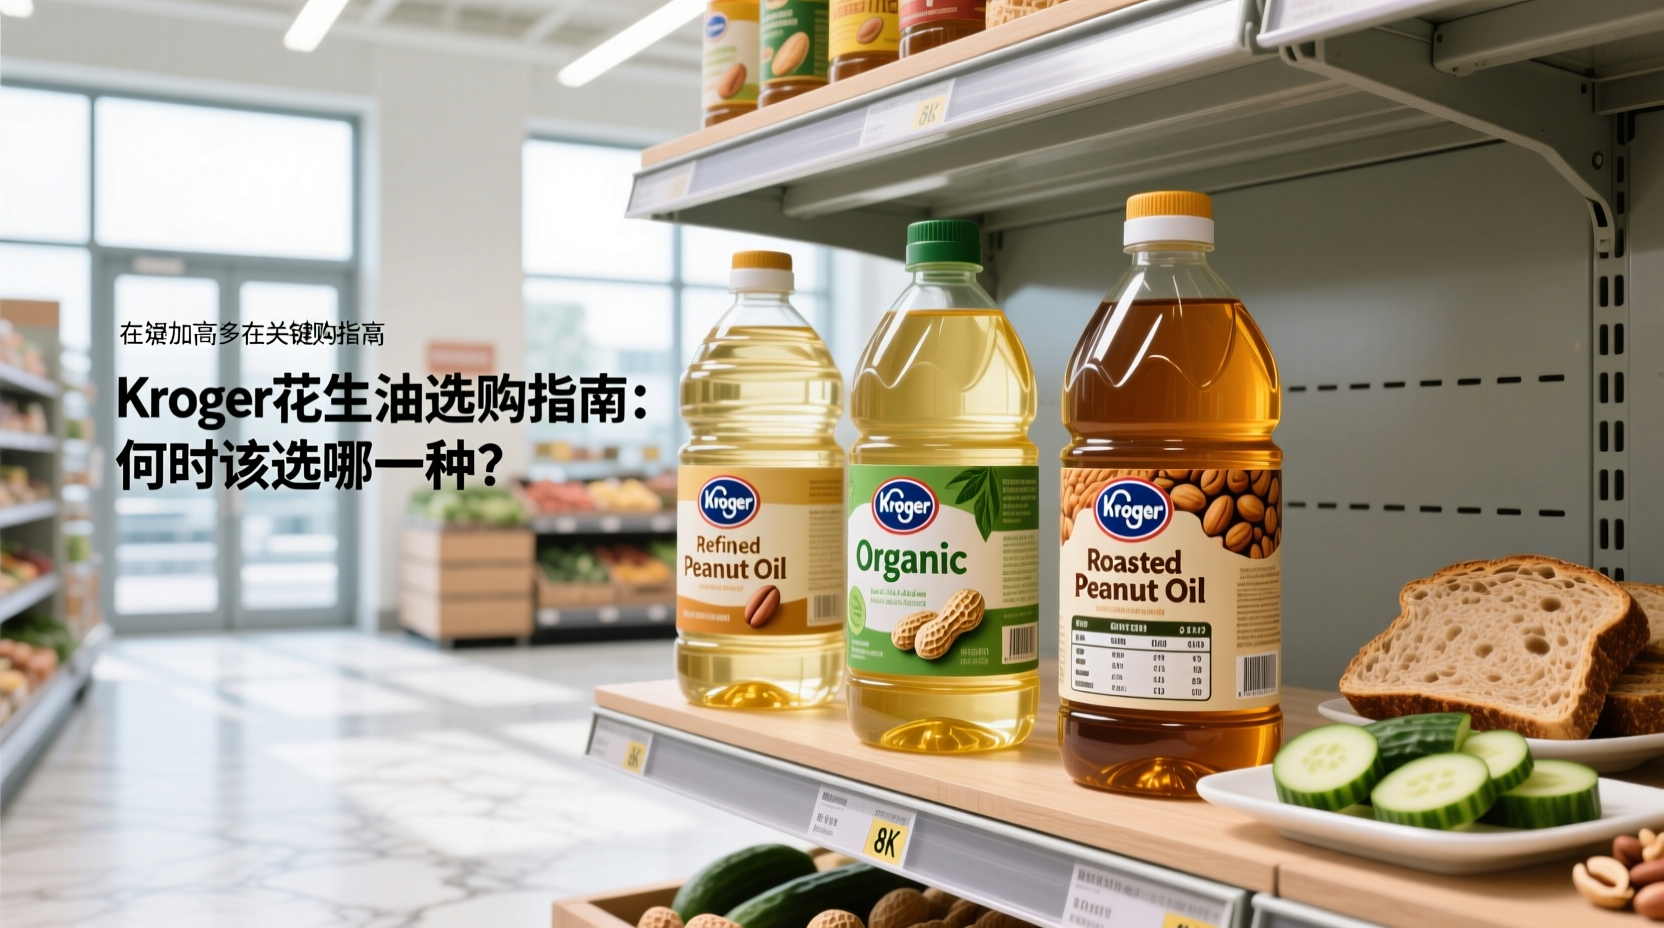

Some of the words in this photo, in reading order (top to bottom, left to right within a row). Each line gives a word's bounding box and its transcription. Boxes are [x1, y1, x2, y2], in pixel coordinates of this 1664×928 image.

[704, 486, 753, 519] Kroger
[879, 488, 931, 524] Kroger
[1103, 489, 1163, 529] Kroger
[696, 535, 760, 555] Refined
[856, 539, 968, 582] Organic
[684, 555, 749, 579] Peanut
[753, 556, 787, 580] Oil
[1087, 548, 1182, 574] Roasted
[1075, 573, 1159, 602] Peanut
[1165, 576, 1206, 603] Oil
[873, 827, 901, 858] 8K
